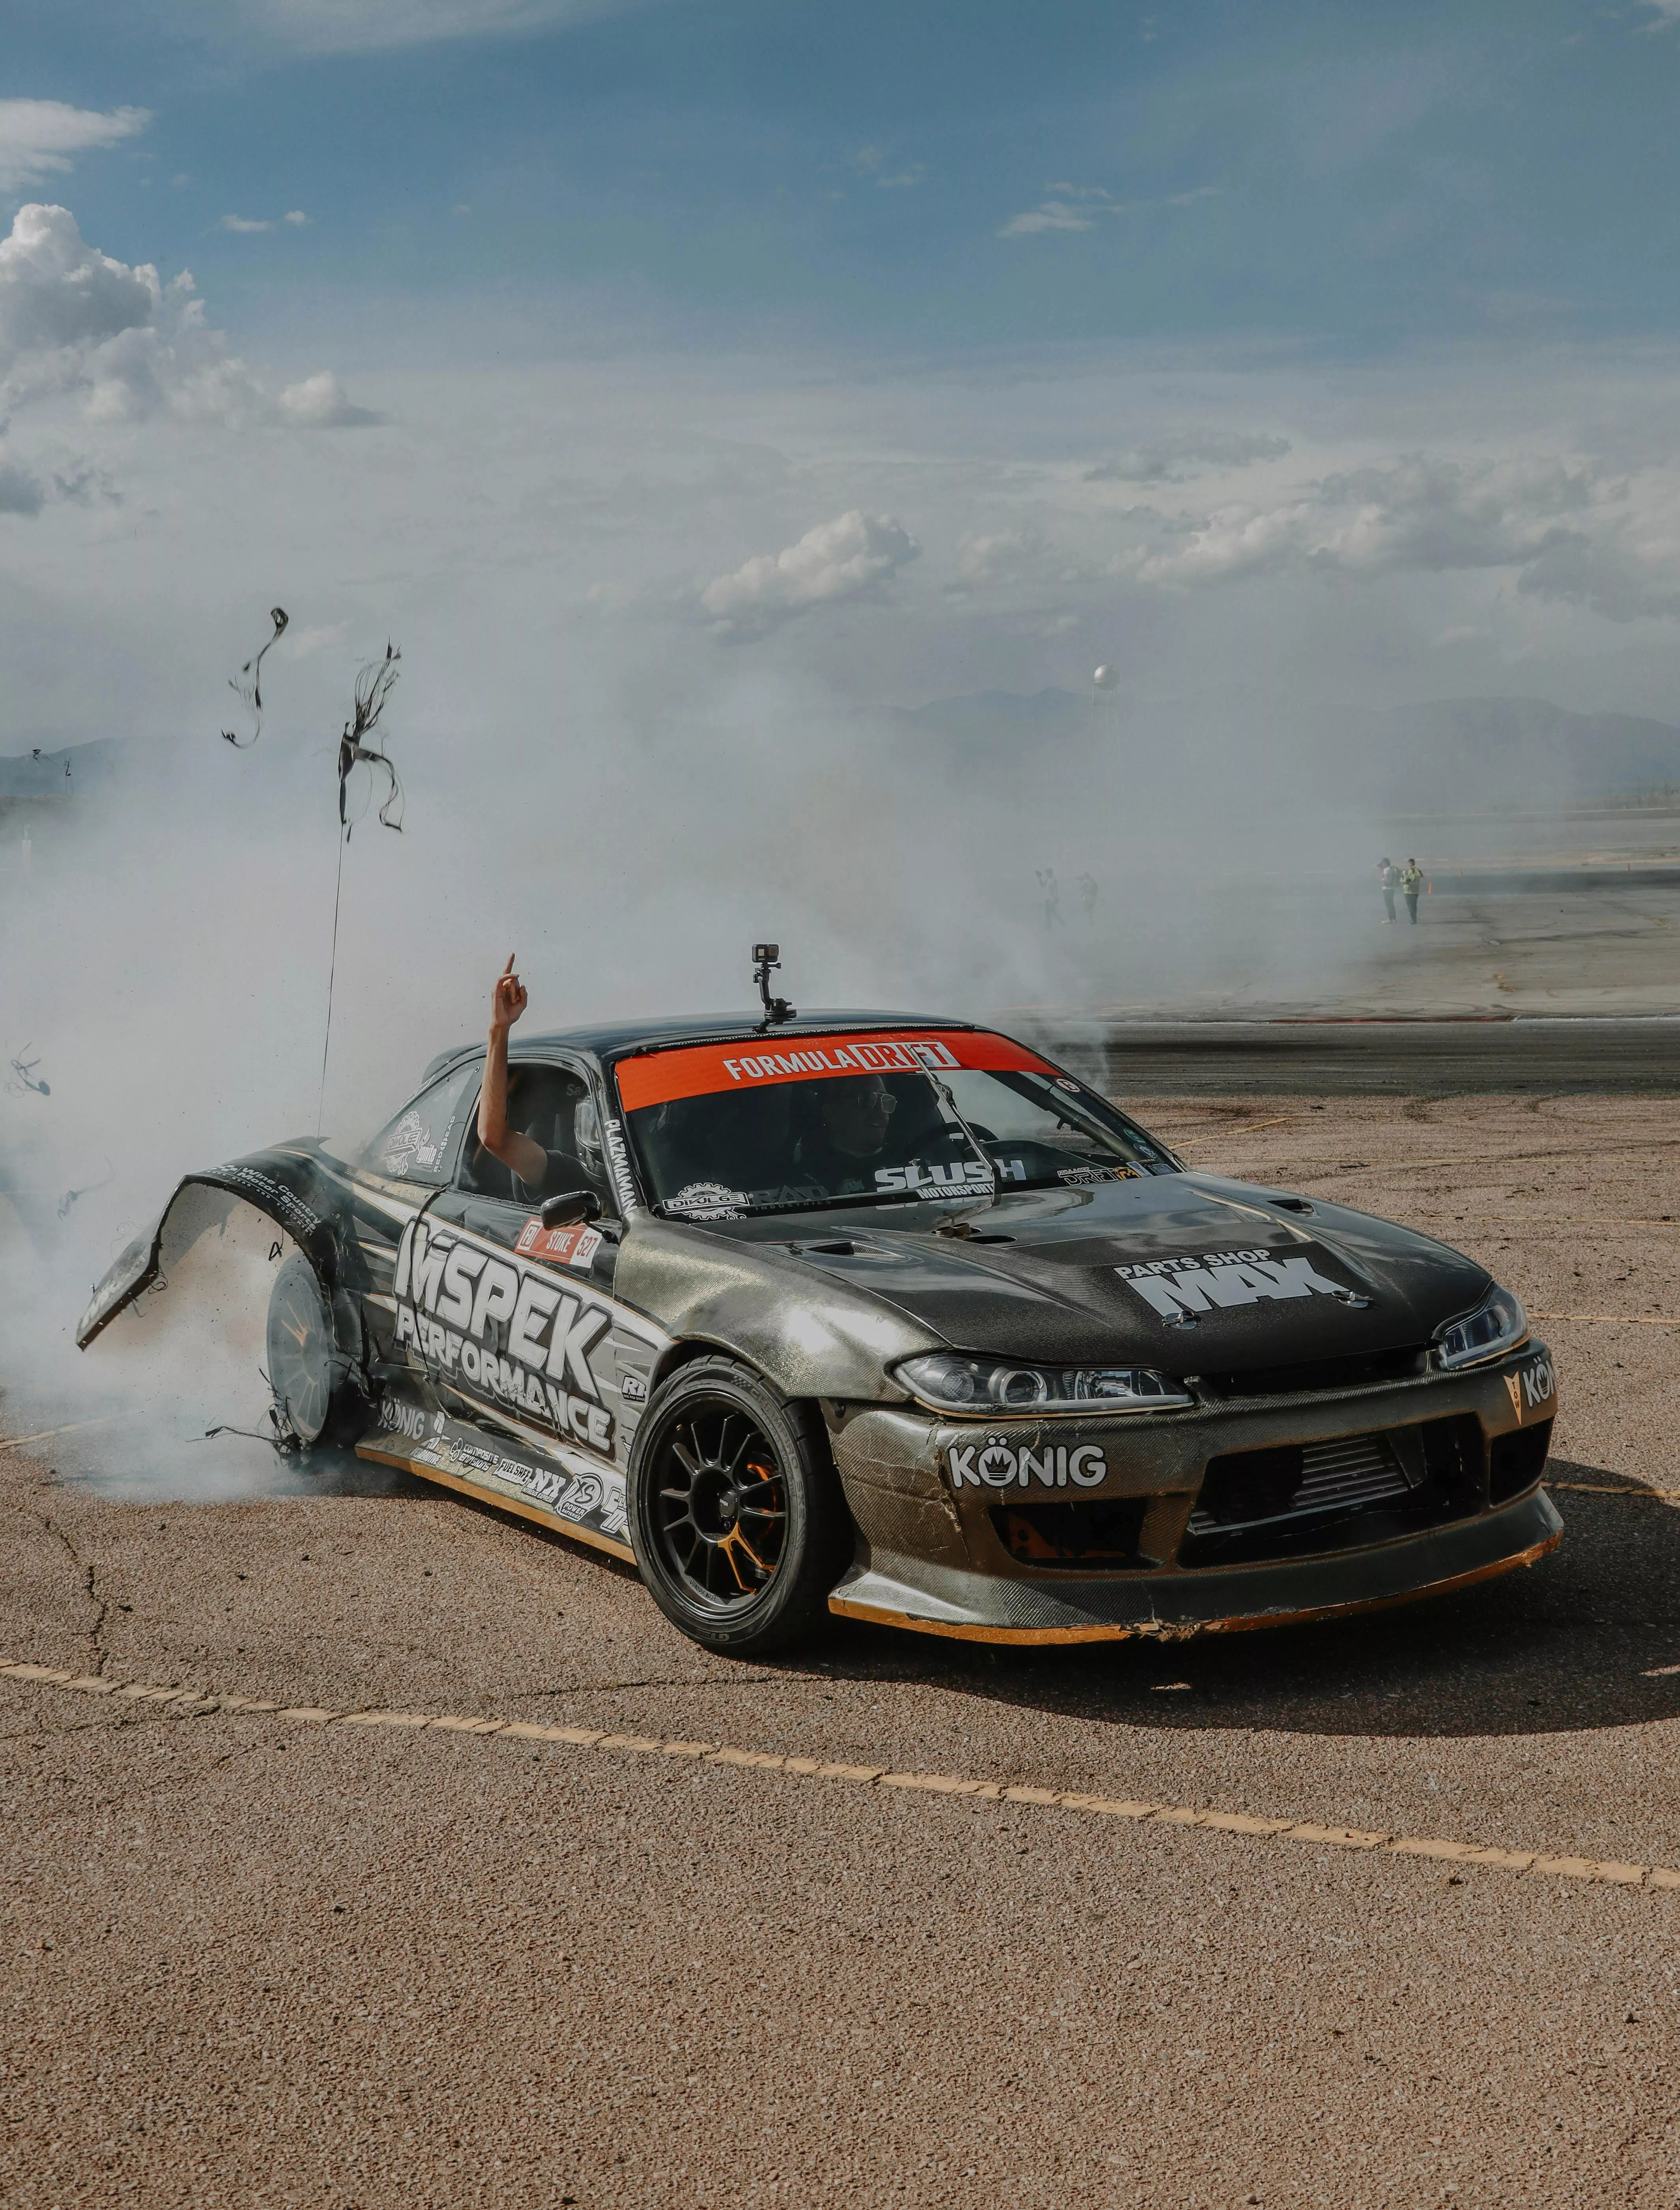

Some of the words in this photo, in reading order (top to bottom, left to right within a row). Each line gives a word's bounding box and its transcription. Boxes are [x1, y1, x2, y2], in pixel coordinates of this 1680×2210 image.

[723, 1048, 859, 1080] FORMULA
[857, 1044, 949, 1068] DRIFT
[604, 1119, 638, 1214] PLAZMAMAN
[874, 1159, 1027, 1192] SLUSH
[1064, 1168, 1119, 1186] DRIFT
[232, 1177, 252, 1187] GEAR
[256, 1189, 271, 1199] AND
[277, 1203, 312, 1237] EQUIPMENT
[237, 1172, 279, 1194] Motor
[280, 1195, 316, 1231] Sports
[242, 1167, 276, 1185] Wine
[278, 1185, 322, 1224] Country
[673, 1195, 740, 1207] DIVULGE
[546, 1231, 575, 1253] STUKE
[576, 1236, 599, 1257] 527
[1113, 1257, 1202, 1279] PARTS
[1203, 1249, 1271, 1266] SHOP
[1125, 1257, 1350, 1317] MAX
[396, 1303, 611, 1451] PERFORMANCE
[378, 1397, 425, 1440] KÖNIG
[458, 1453, 492, 1471] ENVISIONS
[463, 1443, 500, 1464] COMPOSITE
[949, 1437, 1106, 1488] KÖNIG
[497, 1460, 514, 1475] FUEL
[514, 1466, 531, 1482] SAFE
[527, 1467, 567, 1499] NX
[522, 1487, 539, 1497] NITROUS
[537, 1491, 554, 1503] EXPRESS
[563, 1502, 585, 1516] POWER
[561, 1508, 581, 1519] BATTERIES
